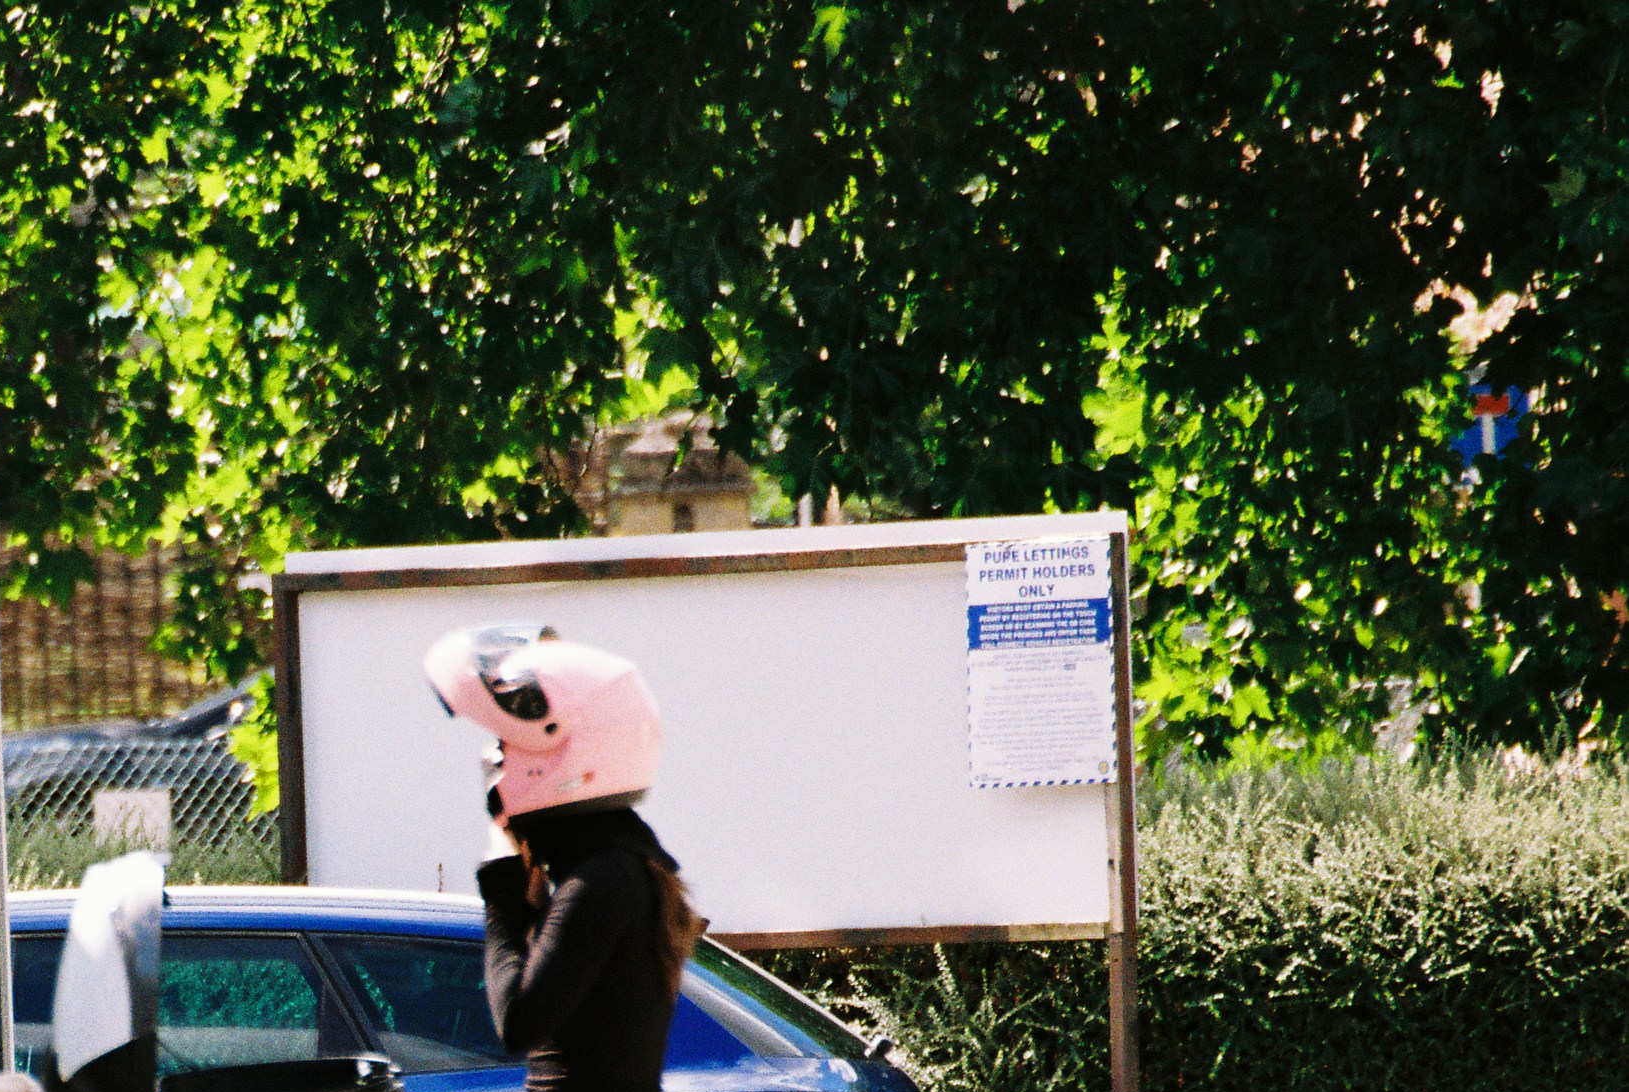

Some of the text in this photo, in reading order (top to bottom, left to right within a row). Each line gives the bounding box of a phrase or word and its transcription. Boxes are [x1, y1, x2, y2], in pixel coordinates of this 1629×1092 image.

[1023, 546, 1090, 562] LETTINGS
[979, 564, 1096, 582] PERMIT HOLDERS
[1018, 584, 1055, 598] ONLY
